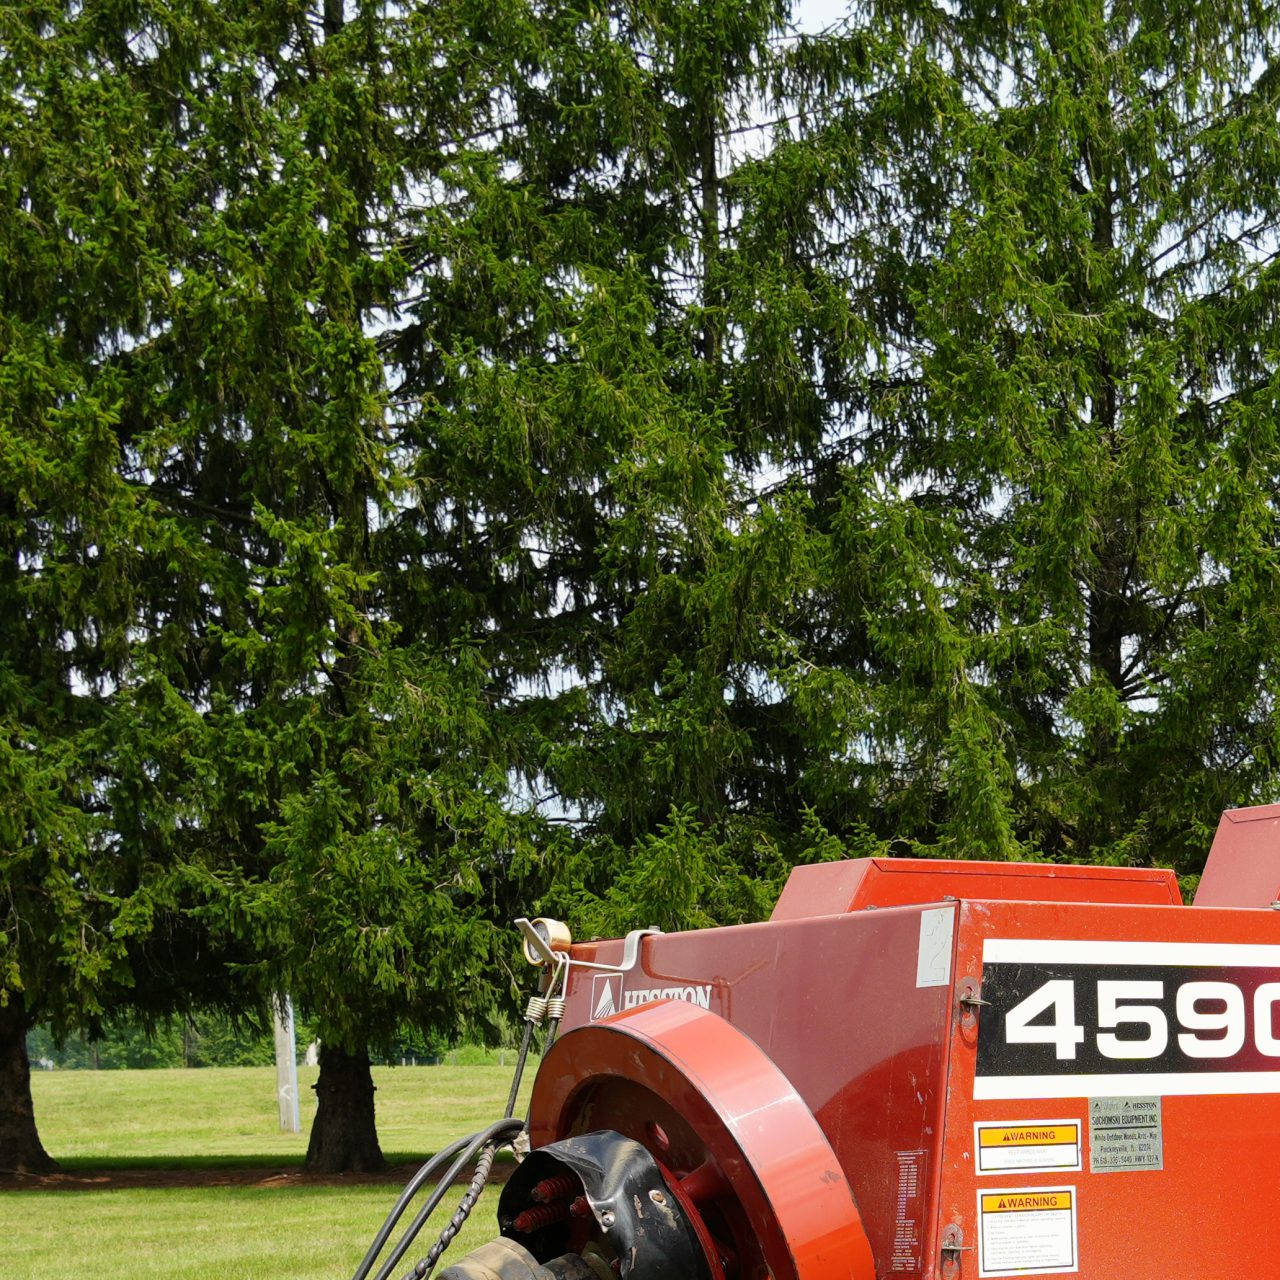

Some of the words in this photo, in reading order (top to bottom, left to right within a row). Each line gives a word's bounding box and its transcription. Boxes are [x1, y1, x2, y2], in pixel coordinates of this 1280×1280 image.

[1132, 1102, 1157, 1110] HESSTON
[1011, 1131, 1056, 1141] WARNING
[1007, 1196, 1058, 1208] WARNING
